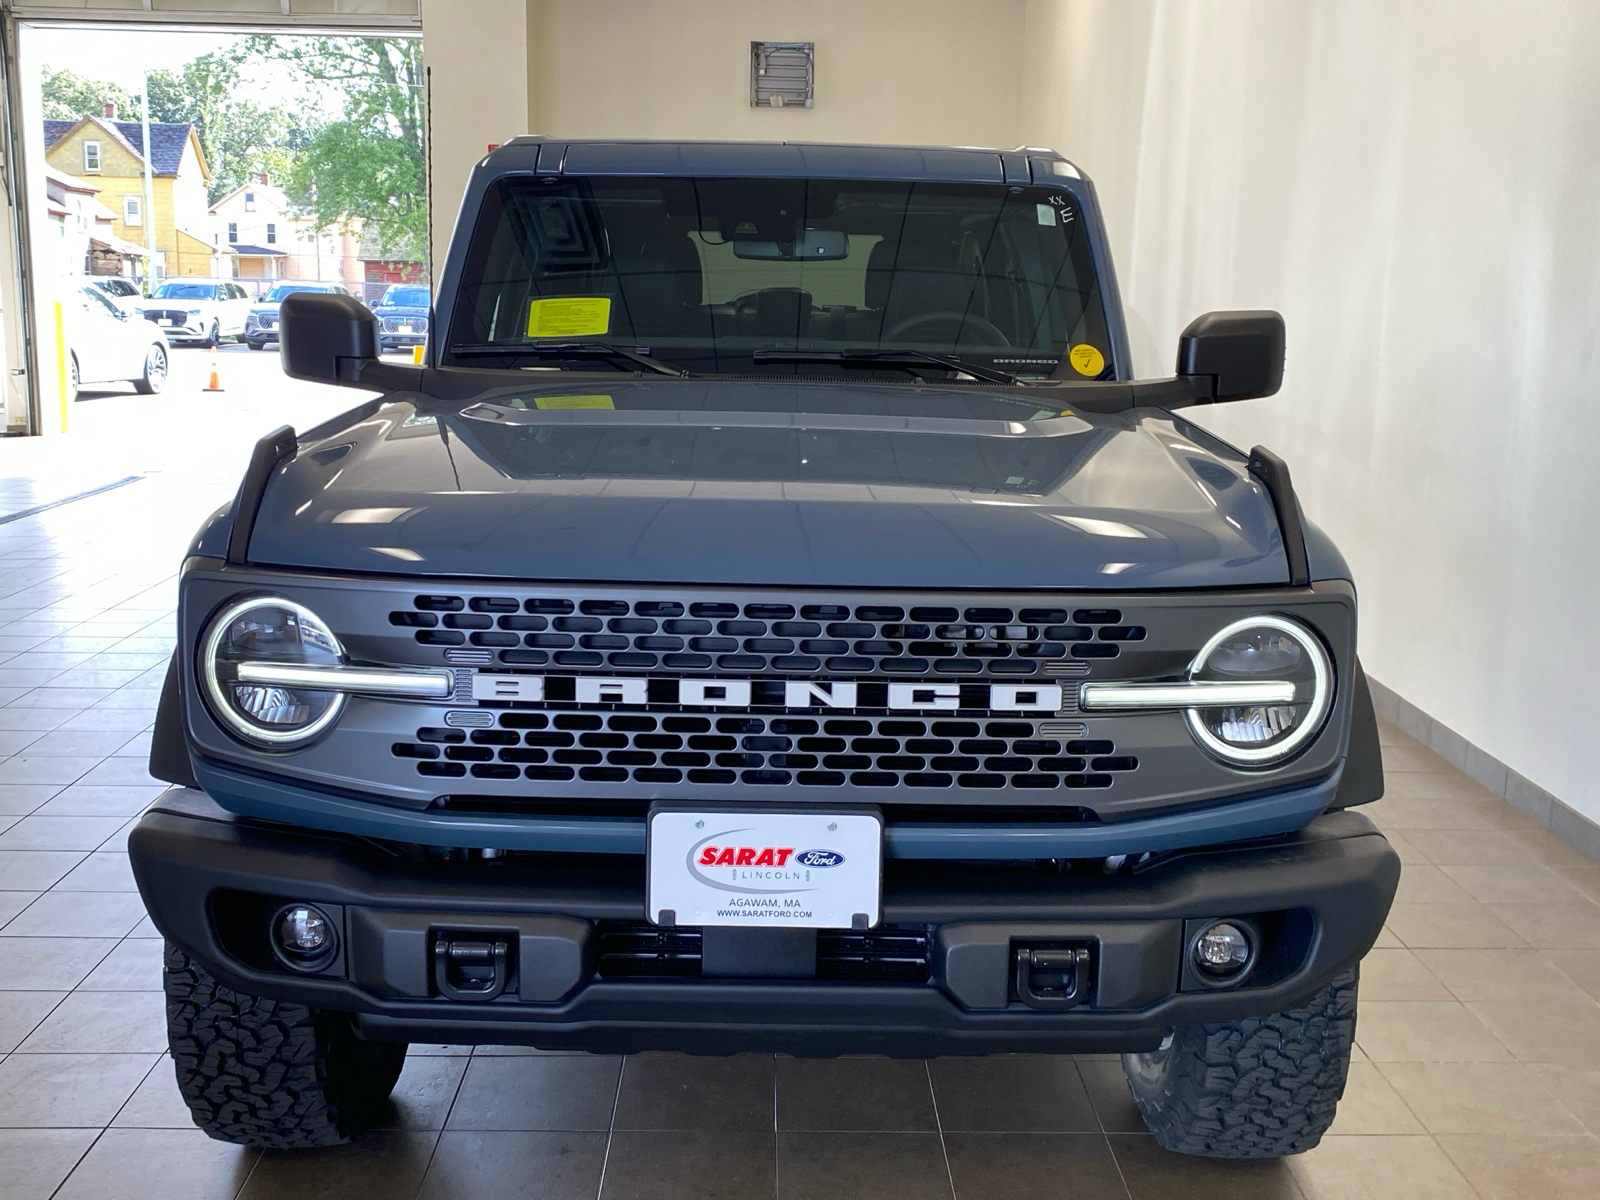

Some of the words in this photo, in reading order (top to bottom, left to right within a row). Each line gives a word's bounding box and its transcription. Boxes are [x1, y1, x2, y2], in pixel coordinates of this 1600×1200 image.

[472, 674, 1063, 711] BRONCO
[697, 845, 796, 868] SARAT
[803, 851, 837, 867] Ford
[742, 871, 801, 880] LINCOLN
[729, 898, 781, 909] AGAWAM,
[784, 899, 801, 908] MA
[717, 909, 813, 919] WWW.SARATFORD.COM
